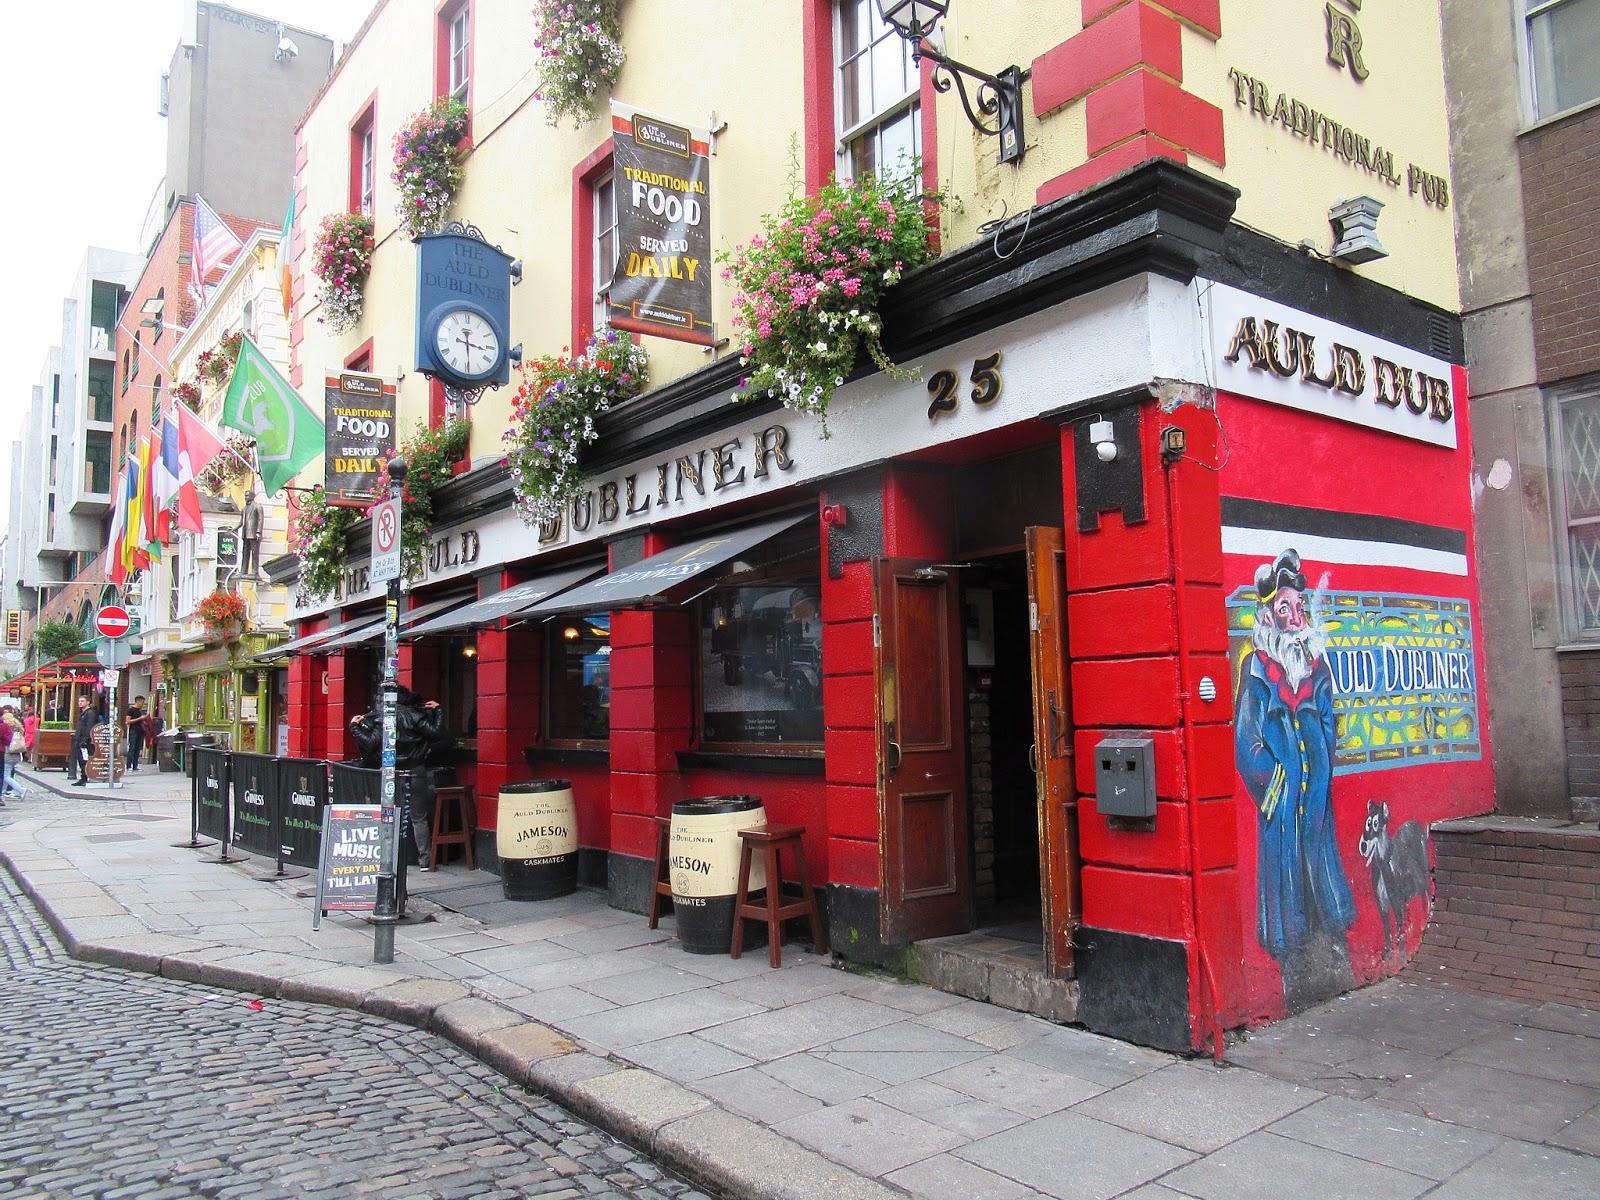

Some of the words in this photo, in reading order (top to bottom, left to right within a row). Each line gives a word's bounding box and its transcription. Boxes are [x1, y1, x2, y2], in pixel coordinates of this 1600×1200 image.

[1326, 0, 1369, 80] R
[641, 126, 667, 139] AULD
[643, 132, 687, 151] DUBLINER
[1228, 66, 1401, 187] TRADITIONAL
[1408, 162, 1449, 208] PUB
[624, 166, 706, 195] TRADITIONAL
[632, 180, 701, 226] FOOD
[453, 242, 484, 261] THE
[640, 235, 688, 253] SERVED
[444, 260, 490, 280] AULD
[626, 252, 699, 281] DAILY
[424, 272, 507, 302] DUBLINER
[1224, 316, 1367, 397] AULD
[1370, 355, 1453, 423] DUB
[927, 349, 1004, 423] 25
[332, 407, 393, 419] TRADITIONAL
[336, 415, 390, 439] FOOD
[342, 447, 380, 456] SERVED
[335, 457, 388, 473] DAILY
[1382, 642, 1473, 692] DUBLINER
[513, 811, 534, 819] AULD
[535, 808, 569, 816] DUBLINER
[341, 826, 380, 844] LIVE
[516, 825, 569, 843] JAMESON
[676, 834, 714, 844] DUBLINER
[332, 865, 361, 875] EVERY
[362, 864, 381, 873] DAY
[523, 856, 565, 866] CASKMATES
[669, 855, 713, 876] AMESON
[327, 876, 352, 888] TILL
[354, 874, 379, 886] LAT
